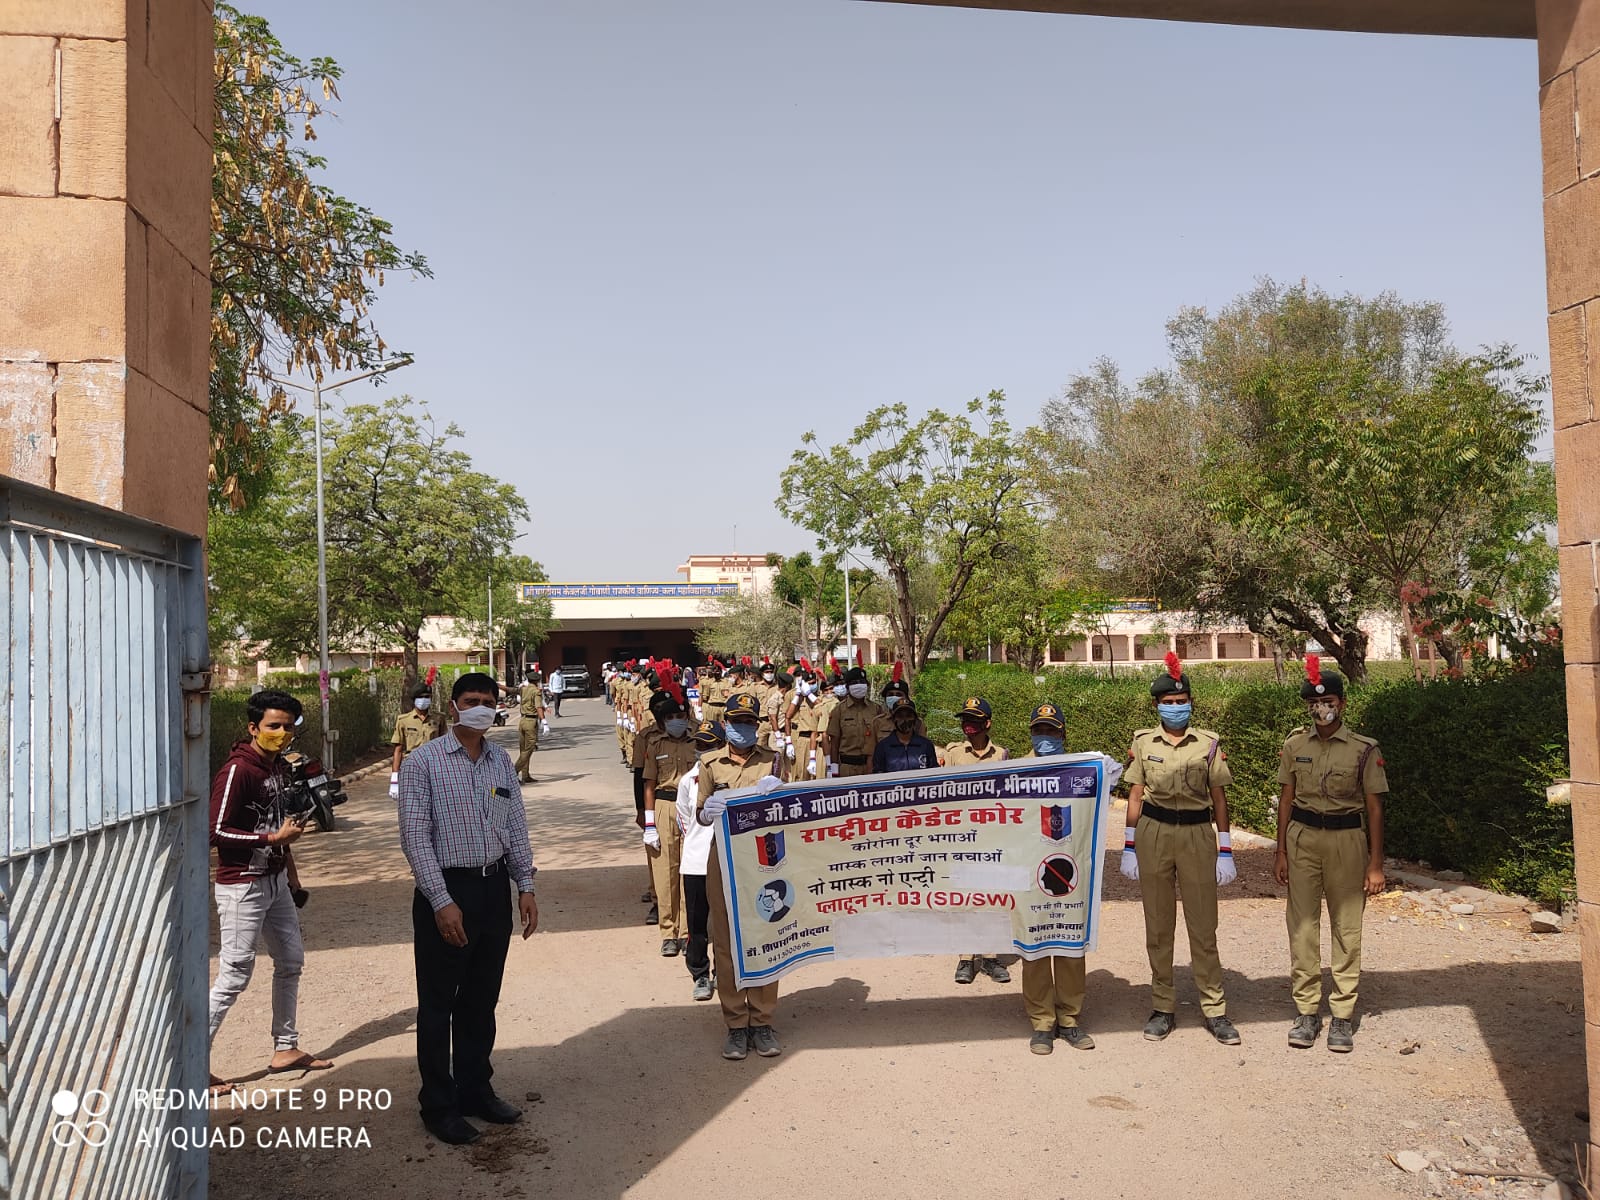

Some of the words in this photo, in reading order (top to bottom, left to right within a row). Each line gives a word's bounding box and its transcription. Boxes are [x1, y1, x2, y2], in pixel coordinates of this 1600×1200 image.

[810, 789, 860, 815] गोवाणी
[861, 785, 915, 808] राजकीय
[918, 778, 1001, 800] महाविद्यालय,
[1005, 774, 1061, 794] भीनमाल
[800, 817, 891, 843] राष्ट्रीय
[895, 806, 963, 830] कैडेट
[968, 803, 1025, 825] कोर
[851, 837, 901, 852] कोरोना
[904, 835, 923, 849] दूर
[928, 829, 978, 843] भगाओं
[828, 860, 867, 872] मास्क
[918, 852, 948, 862] जान
[952, 849, 1003, 863] बचाओं
[808, 878, 826, 896] नो
[829, 876, 872, 892] मास्क
[877, 868, 895, 885] नो
[899, 866, 936, 888] एन्ट्री
[816, 894, 869, 914] प्लाटून
[871, 889, 892, 907] नं.
[898, 891, 921, 905] 03
[927, 891, 1016, 910] (SD/SW)
